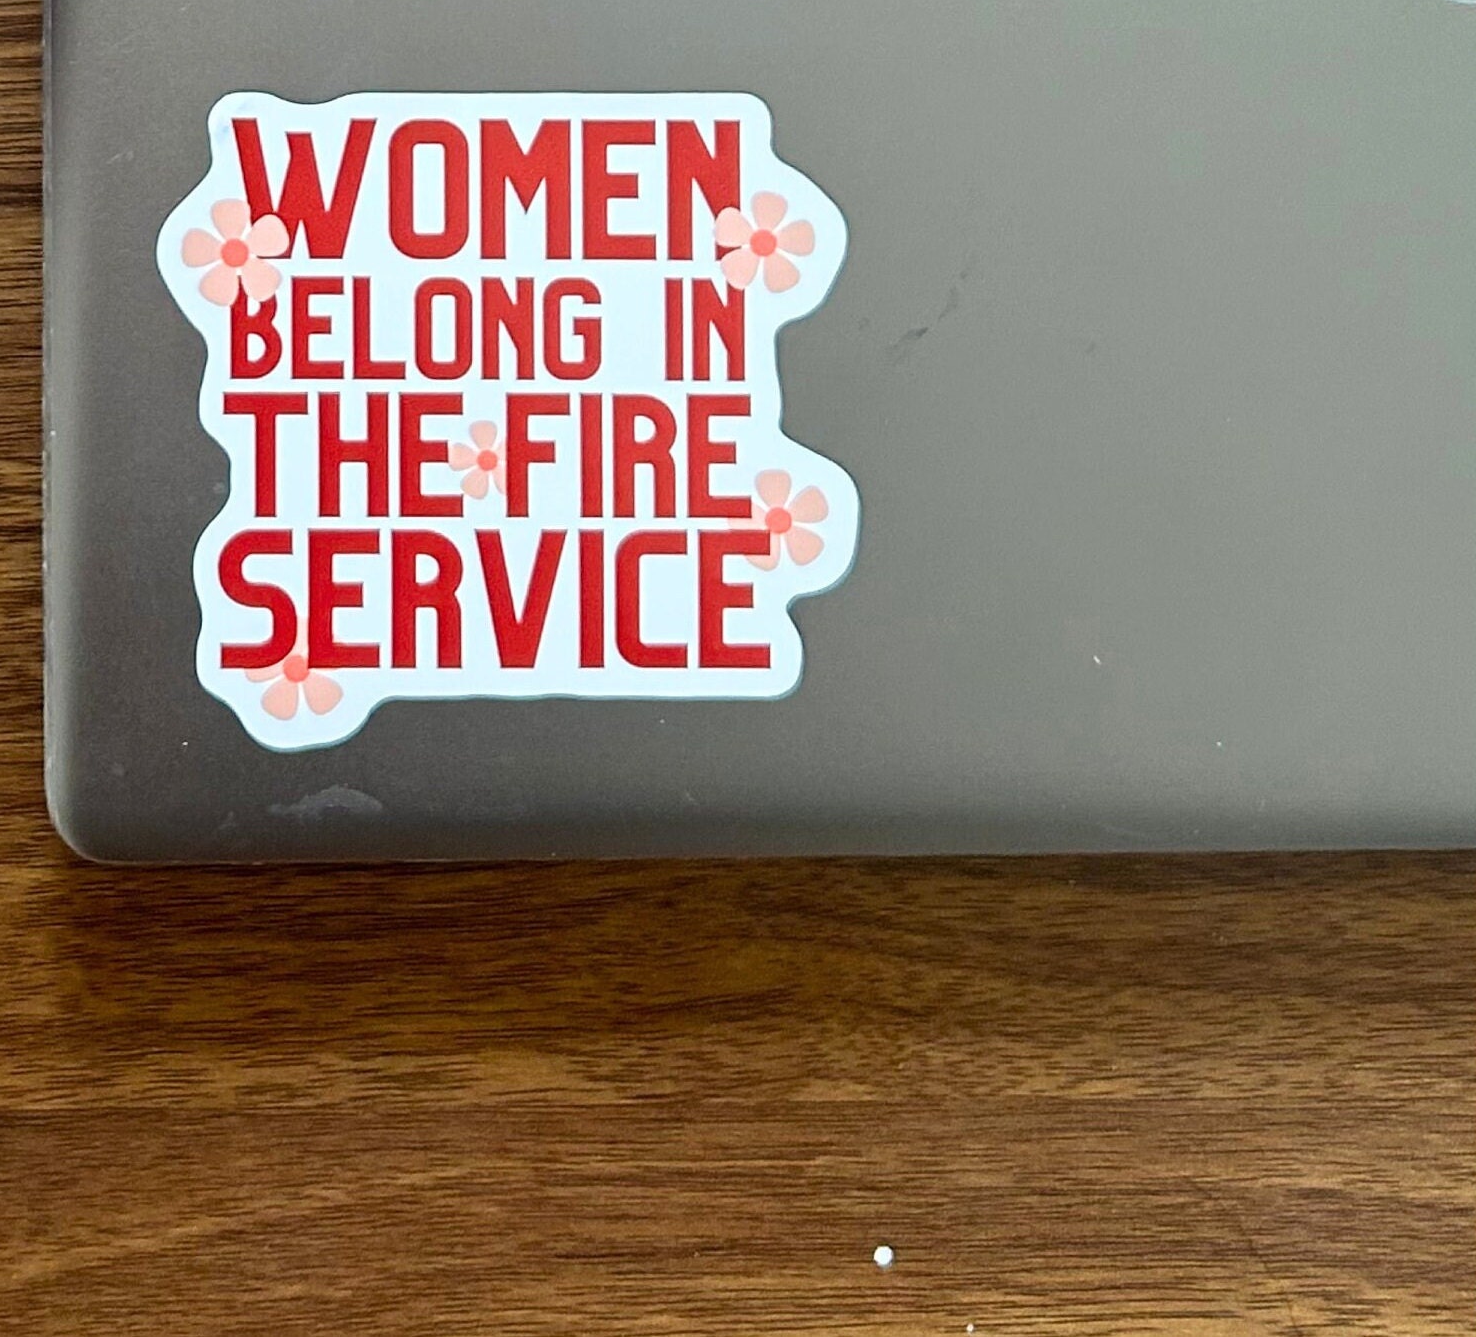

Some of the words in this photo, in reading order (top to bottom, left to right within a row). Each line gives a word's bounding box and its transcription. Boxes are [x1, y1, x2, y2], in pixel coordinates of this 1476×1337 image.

[233, 119, 740, 260] WOMEN
[230, 277, 601, 380] BELONG
[666, 280, 744, 380] IN
[223, 393, 463, 517] THE
[506, 394, 752, 519] FIRE
[218, 530, 771, 670] SERVICE
